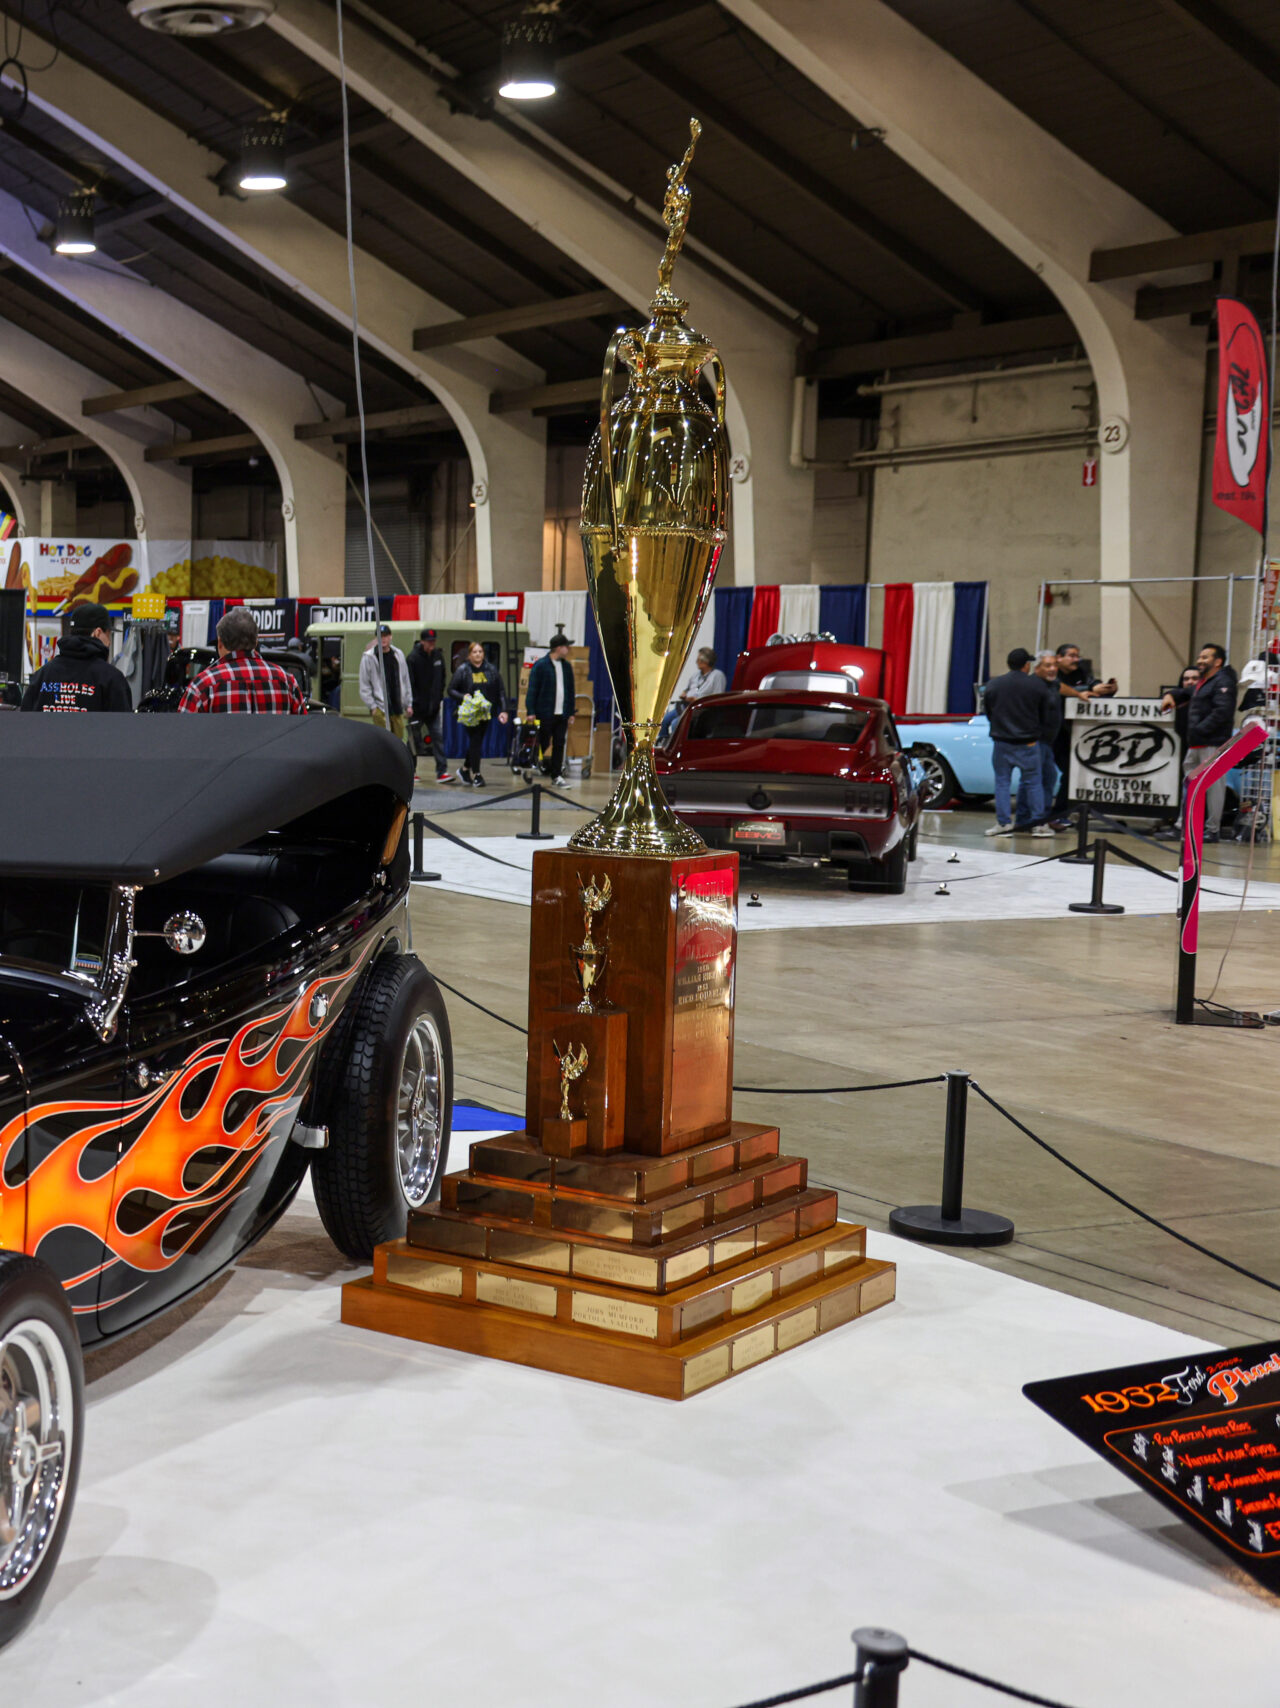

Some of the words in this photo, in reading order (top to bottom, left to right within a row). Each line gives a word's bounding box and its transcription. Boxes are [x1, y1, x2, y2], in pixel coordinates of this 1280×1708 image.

[1104, 425, 1120, 443] 23
[40, 543, 64, 557] HOT
[67, 543, 92, 557] DOG
[40, 682, 96, 696] ASSHOLES
[54, 694, 76, 705] LIVE
[1077, 703, 1112, 716] BILL
[1117, 704, 1163, 717] DUNN
[1093, 778, 1151, 792] CUSTOM
[1075, 788, 1171, 806] UPHOLSTERY
[1081, 1382, 1179, 1413] 1932
[1161, 1365, 1206, 1406] Ford
[1177, 1453, 1221, 1469] VINTAGE
[1217, 1447, 1247, 1461] COLOR
